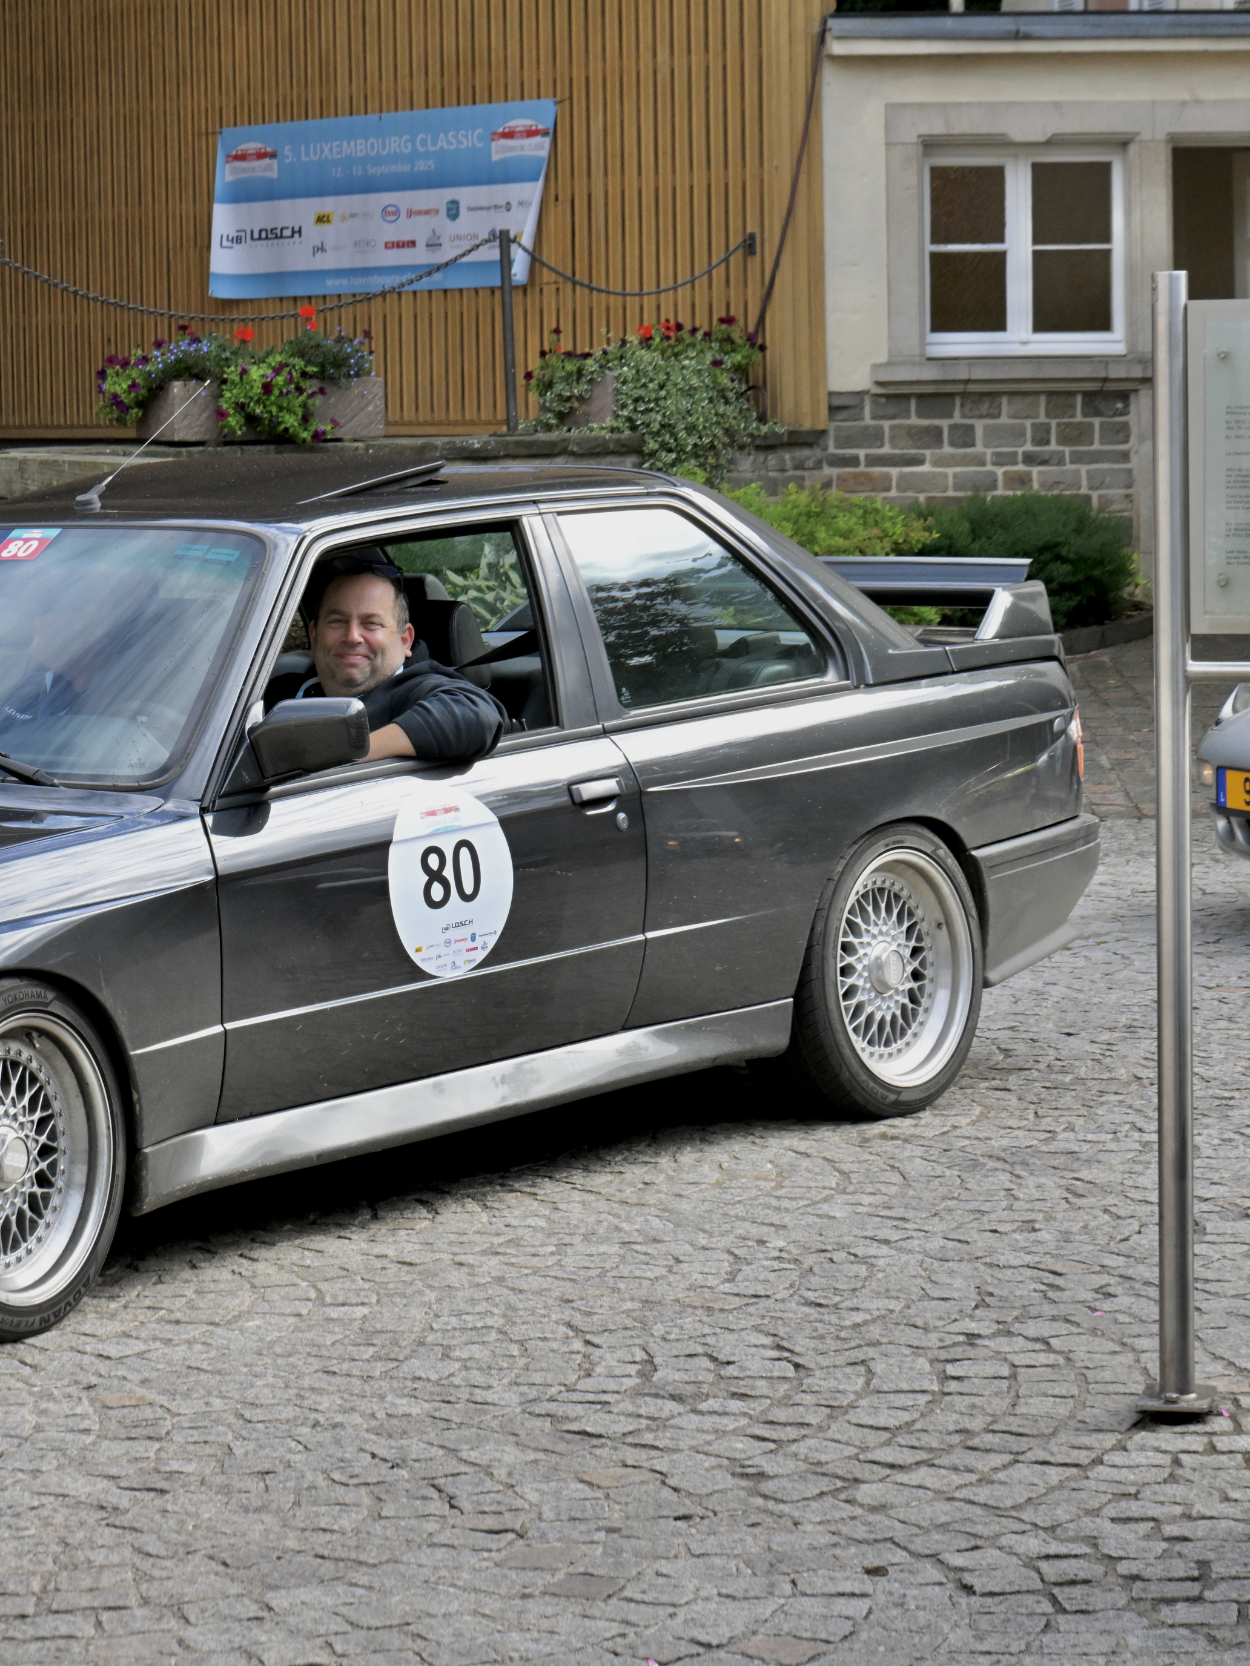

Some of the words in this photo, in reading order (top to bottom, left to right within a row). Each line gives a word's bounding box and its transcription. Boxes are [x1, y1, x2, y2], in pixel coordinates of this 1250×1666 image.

[284, 145, 297, 163] 5.
[301, 134, 412, 162] LUXEMBOURG
[416, 129, 484, 152] CLASSIC
[331, 166, 344, 177] 12.
[367, 162, 410, 176] September
[413, 160, 435, 171] 2025
[315, 214, 332, 224] ACL
[250, 225, 302, 241] LOSCH
[449, 232, 479, 242] UNION
[0, 540, 39, 557] 80
[421, 839, 481, 909] 80
[451, 918, 474, 929] LOSCH
[1, 989, 49, 1006] YOKOHAMA
[39, 1273, 91, 1327] ADVAN
